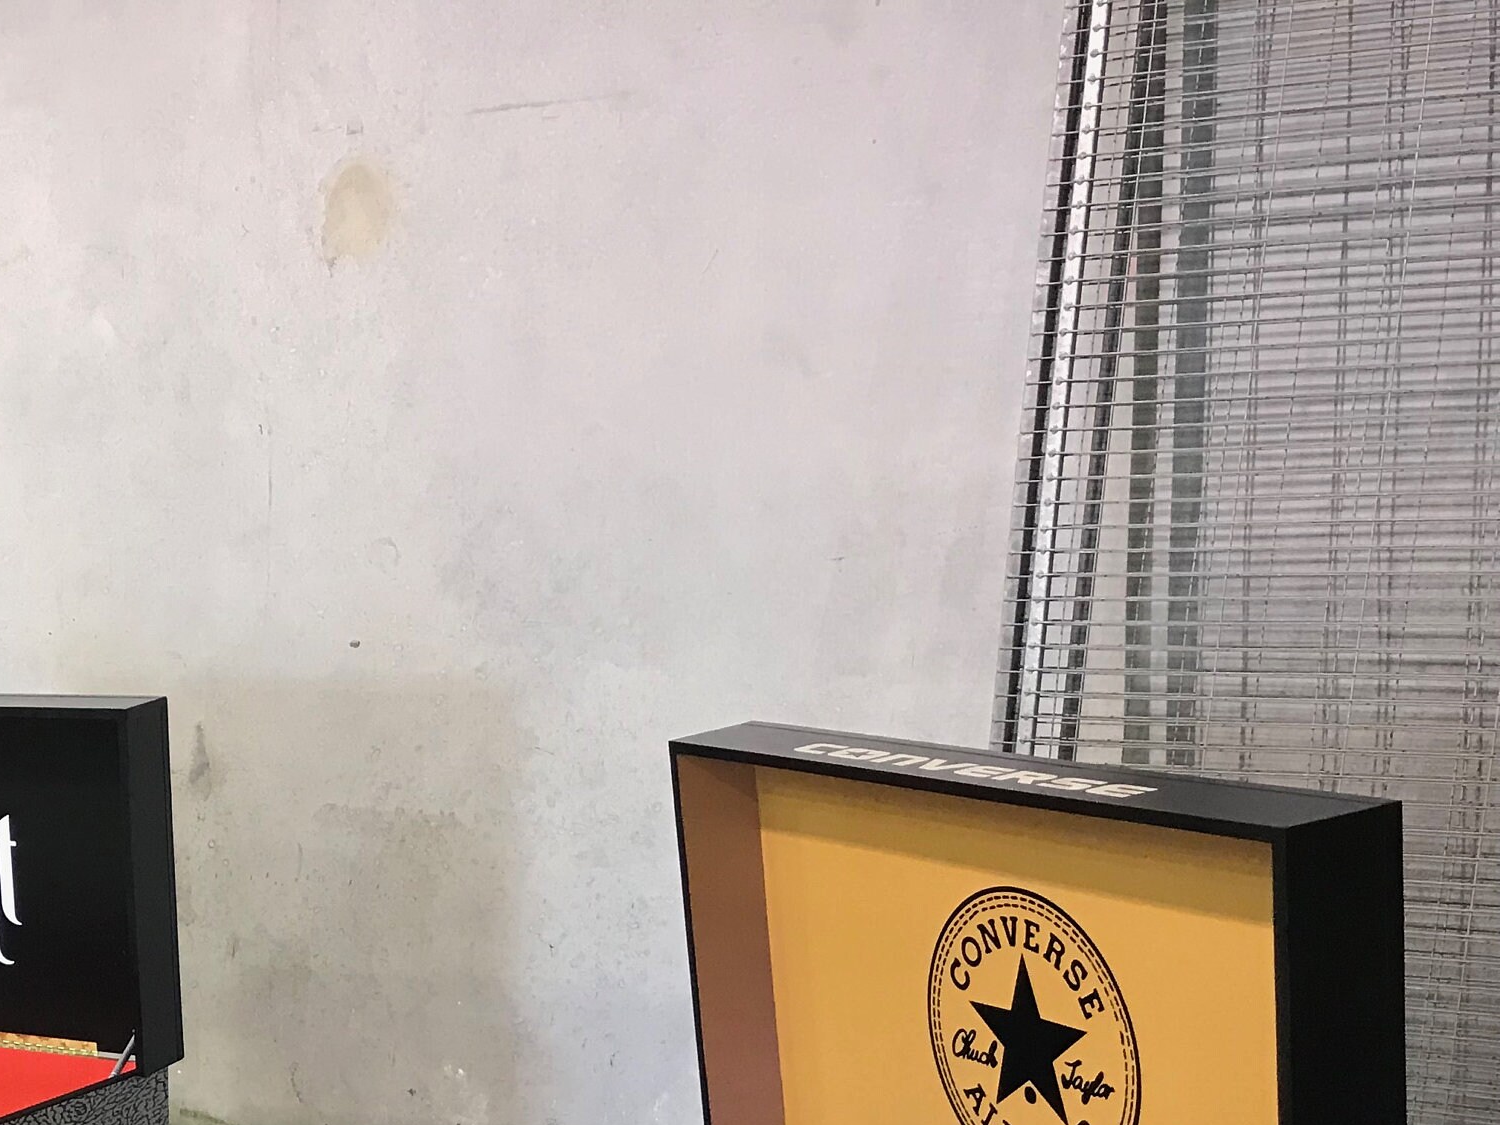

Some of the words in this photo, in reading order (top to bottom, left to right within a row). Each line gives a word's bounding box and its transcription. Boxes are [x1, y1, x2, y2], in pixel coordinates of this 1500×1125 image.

[793, 742, 1159, 799] CONVERSE
[949, 915, 1104, 1020] CONVERSE
[951, 1027, 999, 1069] Chuck
[1060, 1059, 1116, 1105] Taylor
